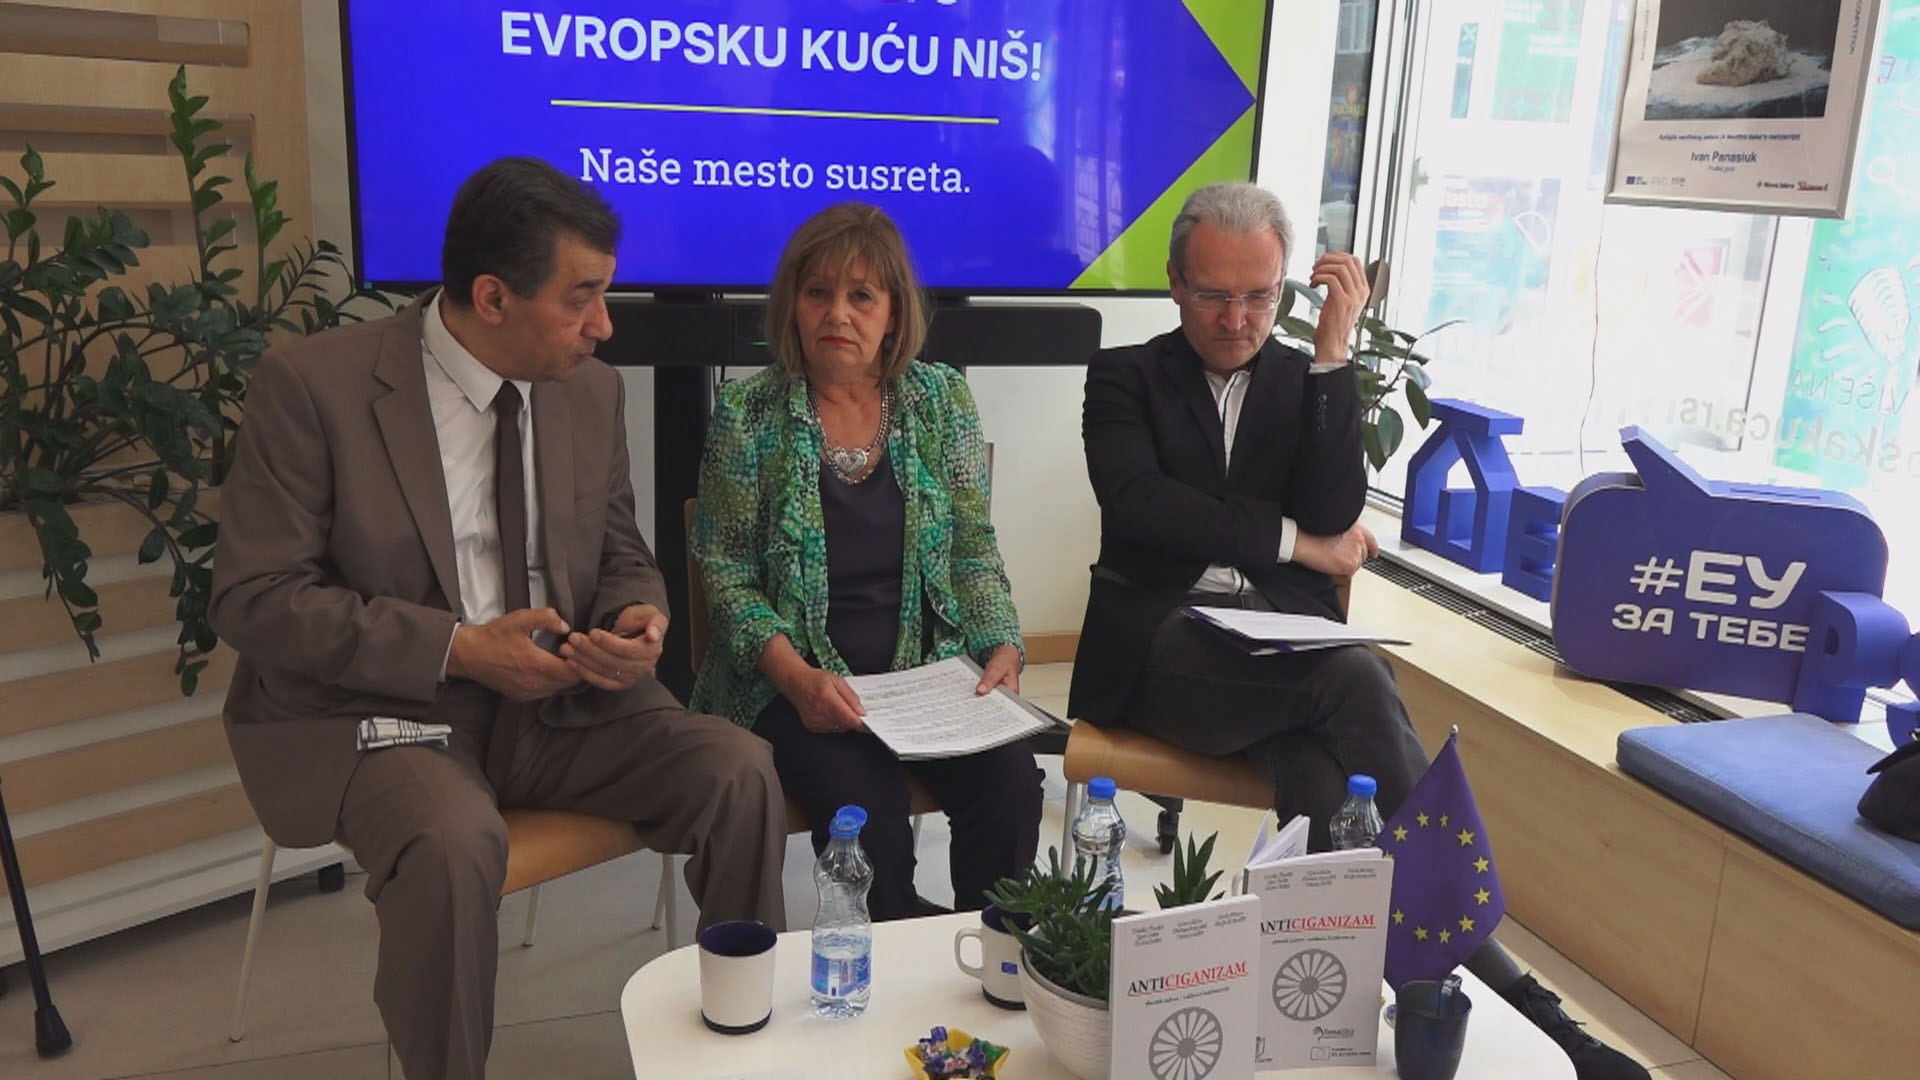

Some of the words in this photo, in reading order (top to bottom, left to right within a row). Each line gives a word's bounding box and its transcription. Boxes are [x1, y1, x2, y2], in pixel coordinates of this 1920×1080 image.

[502, 11, 787, 68] EVROPSKU
[801, 22, 939, 75] KUĆU
[952, 29, 1042, 81] NIŠ!
[579, 148, 682, 185] Naše
[692, 157, 814, 188] mesto
[825, 162, 971, 193] susreta.
[1691, 151, 1710, 162] Ivan
[1712, 150, 1757, 163] Panasiuk
[1630, 550, 1807, 610] #ЕУ
[1612, 604, 1674, 635] ЗА
[1689, 612, 1810, 653] ТЕБЕ
[1128, 960, 1248, 997] ANTICIGANIZAM
